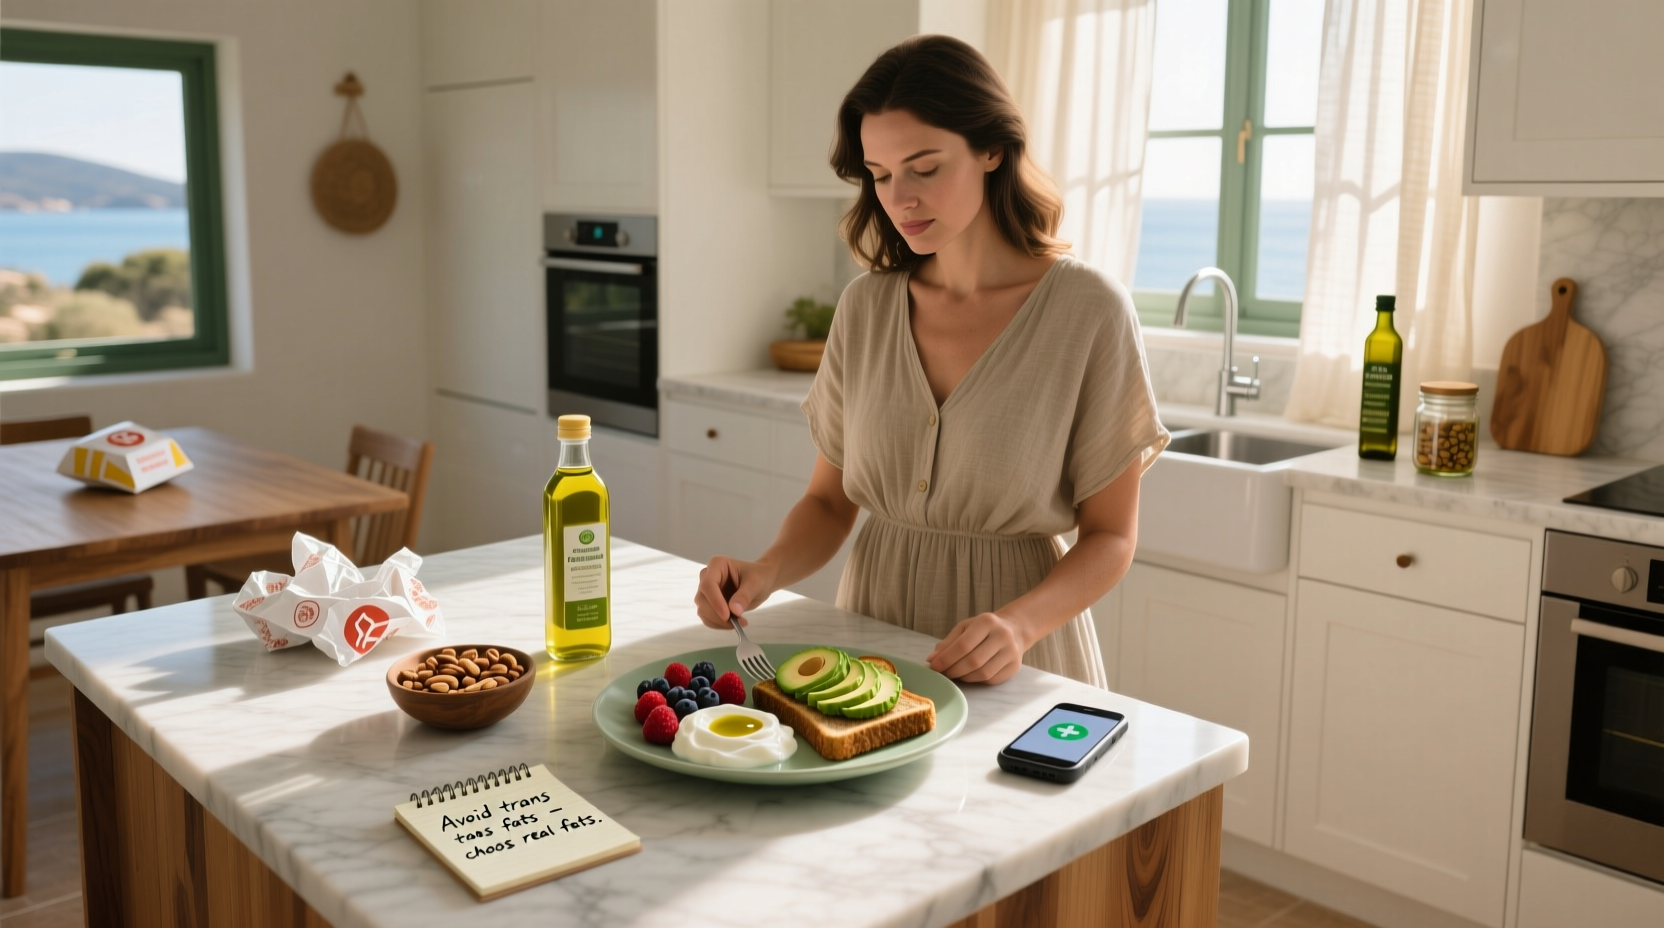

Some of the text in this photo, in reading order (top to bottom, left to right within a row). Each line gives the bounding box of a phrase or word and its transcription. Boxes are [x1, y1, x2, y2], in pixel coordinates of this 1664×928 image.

[442, 791, 550, 832] Avoid trans
[502, 814, 538, 831] fats
[466, 839, 515, 859] choos
[522, 825, 555, 843] real
